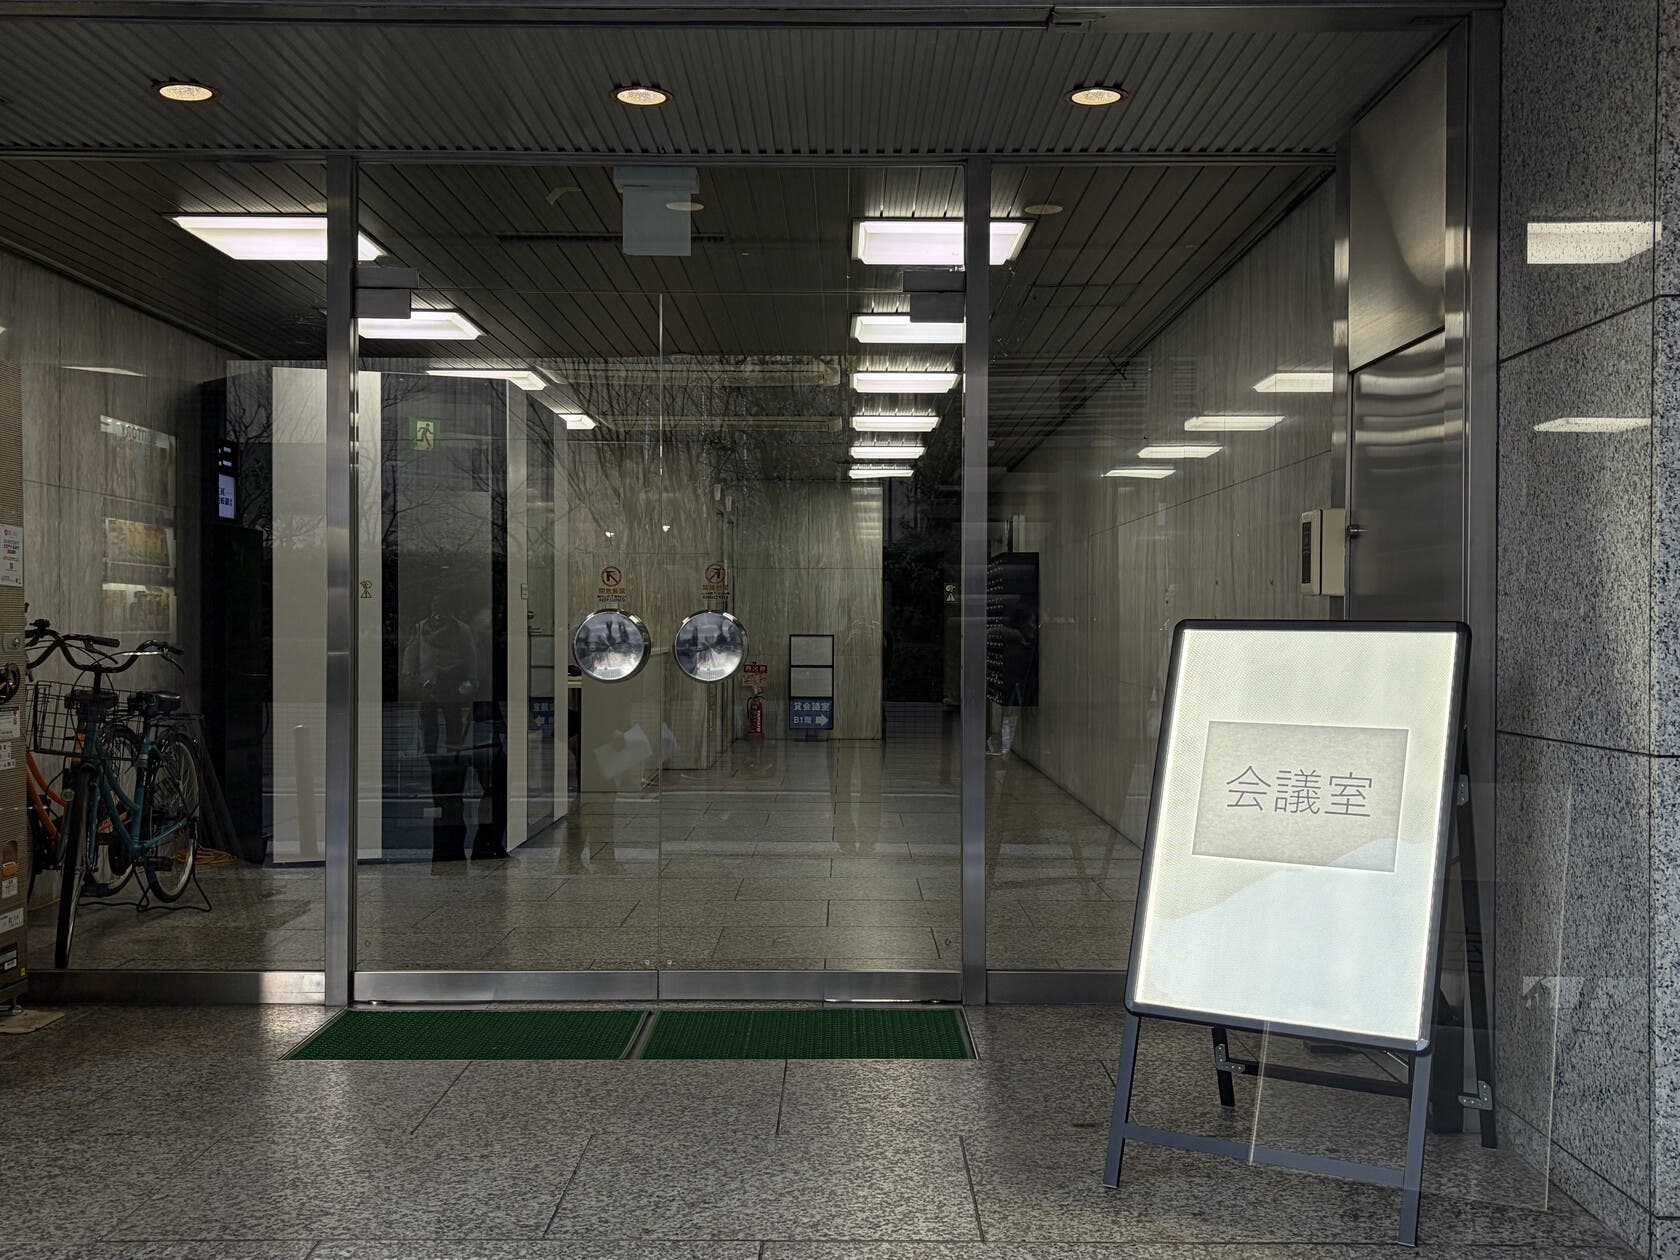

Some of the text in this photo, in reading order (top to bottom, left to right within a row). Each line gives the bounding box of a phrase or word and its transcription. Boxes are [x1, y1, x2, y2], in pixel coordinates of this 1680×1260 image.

[793, 702, 830, 711] 貸会議室
[1226, 765, 1373, 818] 会議室
